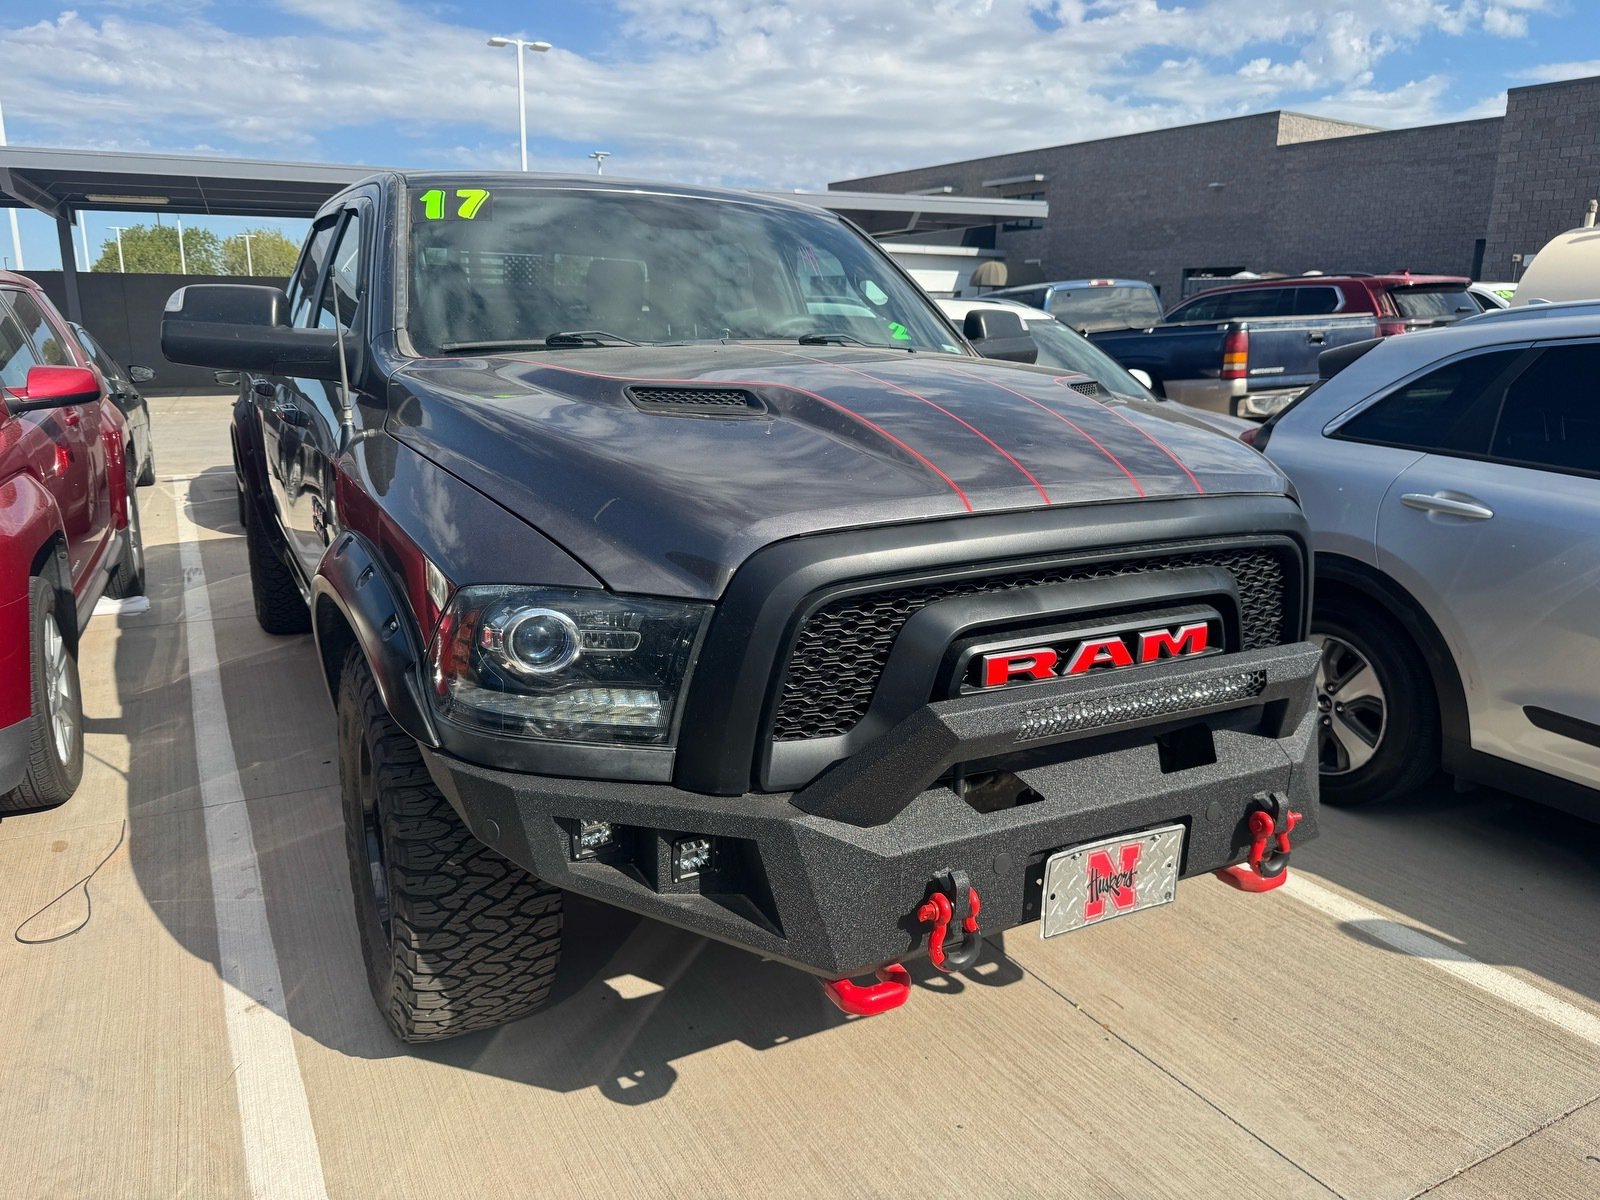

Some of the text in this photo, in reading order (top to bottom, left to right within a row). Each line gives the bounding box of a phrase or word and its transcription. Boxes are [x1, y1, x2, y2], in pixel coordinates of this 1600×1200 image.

[420, 189, 490, 220] 17
[888, 321, 911, 341] 2
[983, 622, 1208, 687] RAM
[1083, 842, 1144, 921] N
[1087, 867, 1138, 903] Huskers
